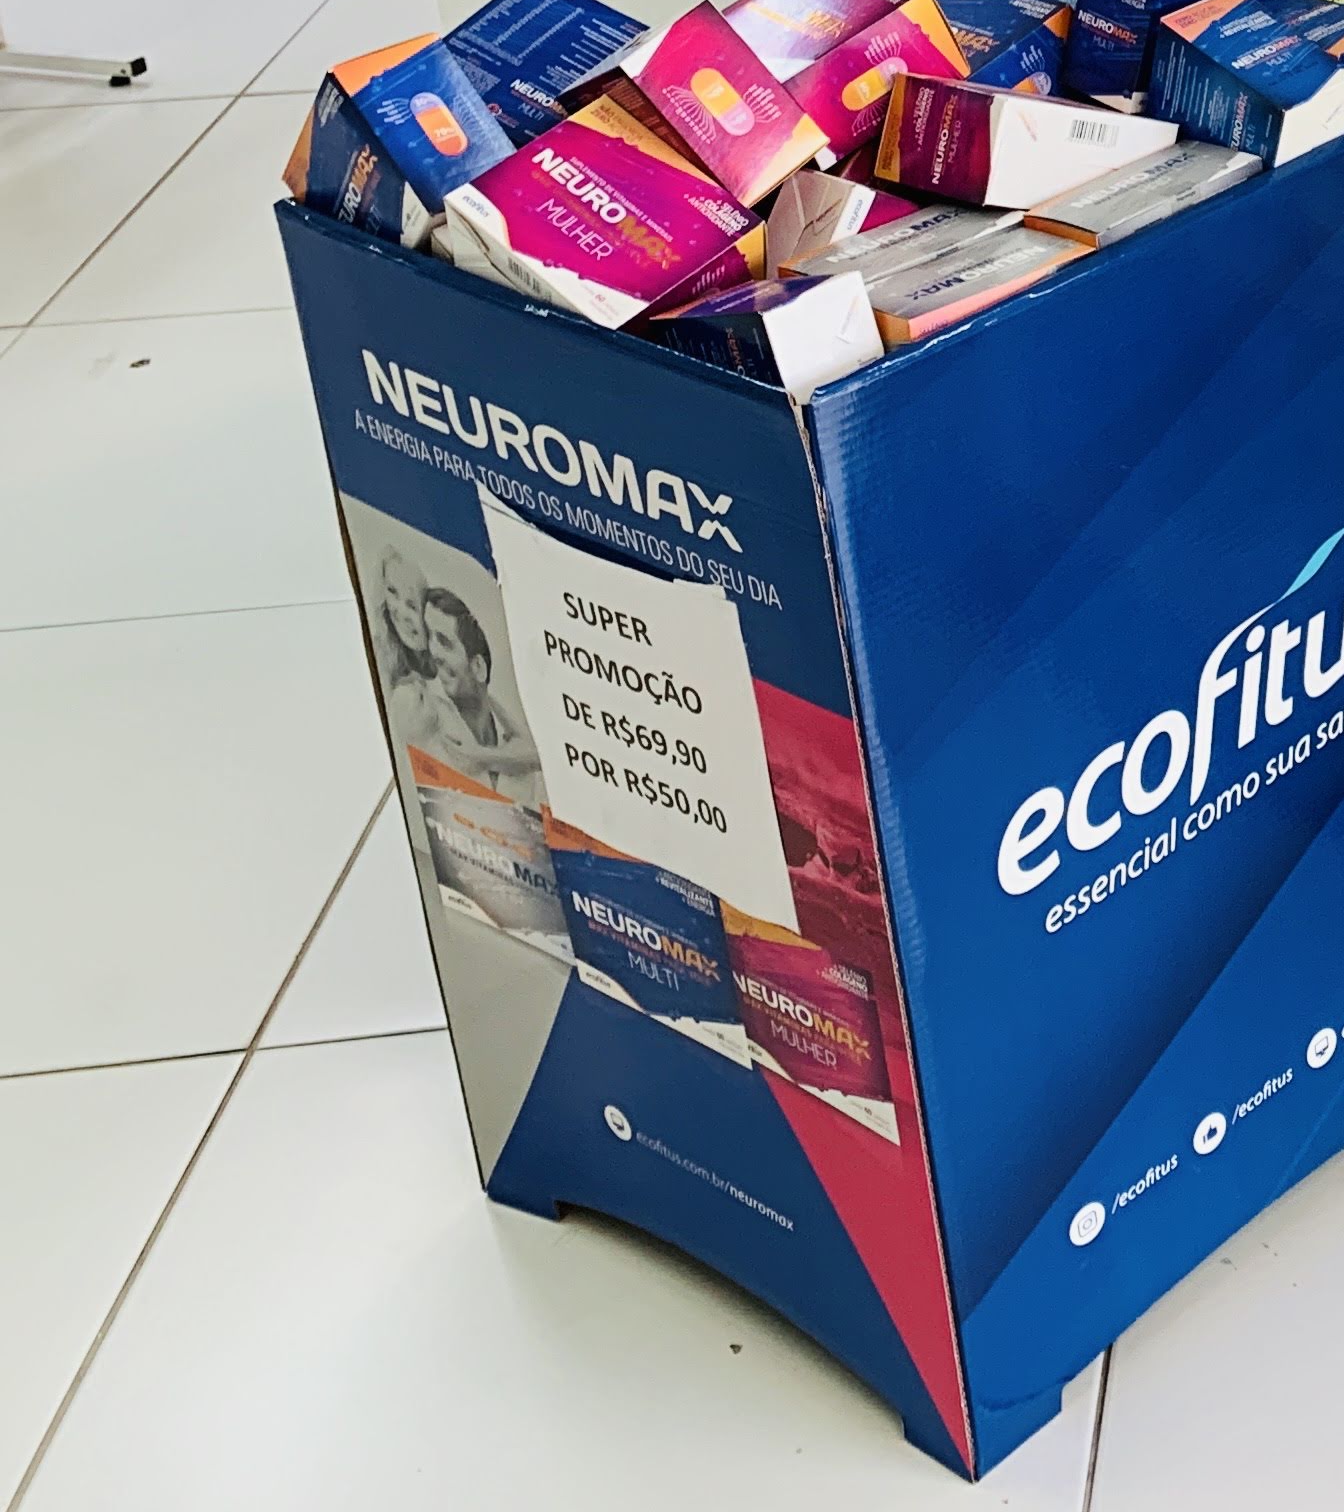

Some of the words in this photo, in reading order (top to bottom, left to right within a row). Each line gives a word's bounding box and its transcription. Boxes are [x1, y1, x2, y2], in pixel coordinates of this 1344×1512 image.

[1078, 10, 1138, 45] NEUROMAX
[1231, 35, 1302, 70] NEUROMAX
[531, 148, 681, 270] NEUROMAX
[538, 198, 614, 261] MULHER
[360, 348, 744, 553] NEUROMAX
[354, 408, 366, 433] A
[367, 414, 432, 468] ENERGIA
[432, 446, 478, 484] PARA
[478, 466, 536, 514] TODOS
[537, 490, 564, 519] OS
[564, 500, 674, 568] MOMENTOS
[676, 546, 706, 578] DO
[708, 558, 746, 597] SEU
[748, 573, 783, 610] DIA
[562, 590, 654, 647] SUPER
[543, 629, 702, 716] PROMOÇÃO
[562, 692, 597, 731] DE
[602, 710, 708, 775] R$69,90
[564, 742, 619, 786] POR
[625, 764, 728, 835] R$50,00
[1044, 816, 1178, 934] essencial
[1180, 770, 1260, 839] como
[1263, 737, 1312, 789] sua
[570, 890, 722, 982] NEUROMAX
[627, 950, 680, 991] MULTI
[769, 1019, 838, 1070] MULHER
[1231, 1065, 1294, 1126] /ecofitus
[635, 1128, 795, 1232] ecofitus.com.br/neuromax
